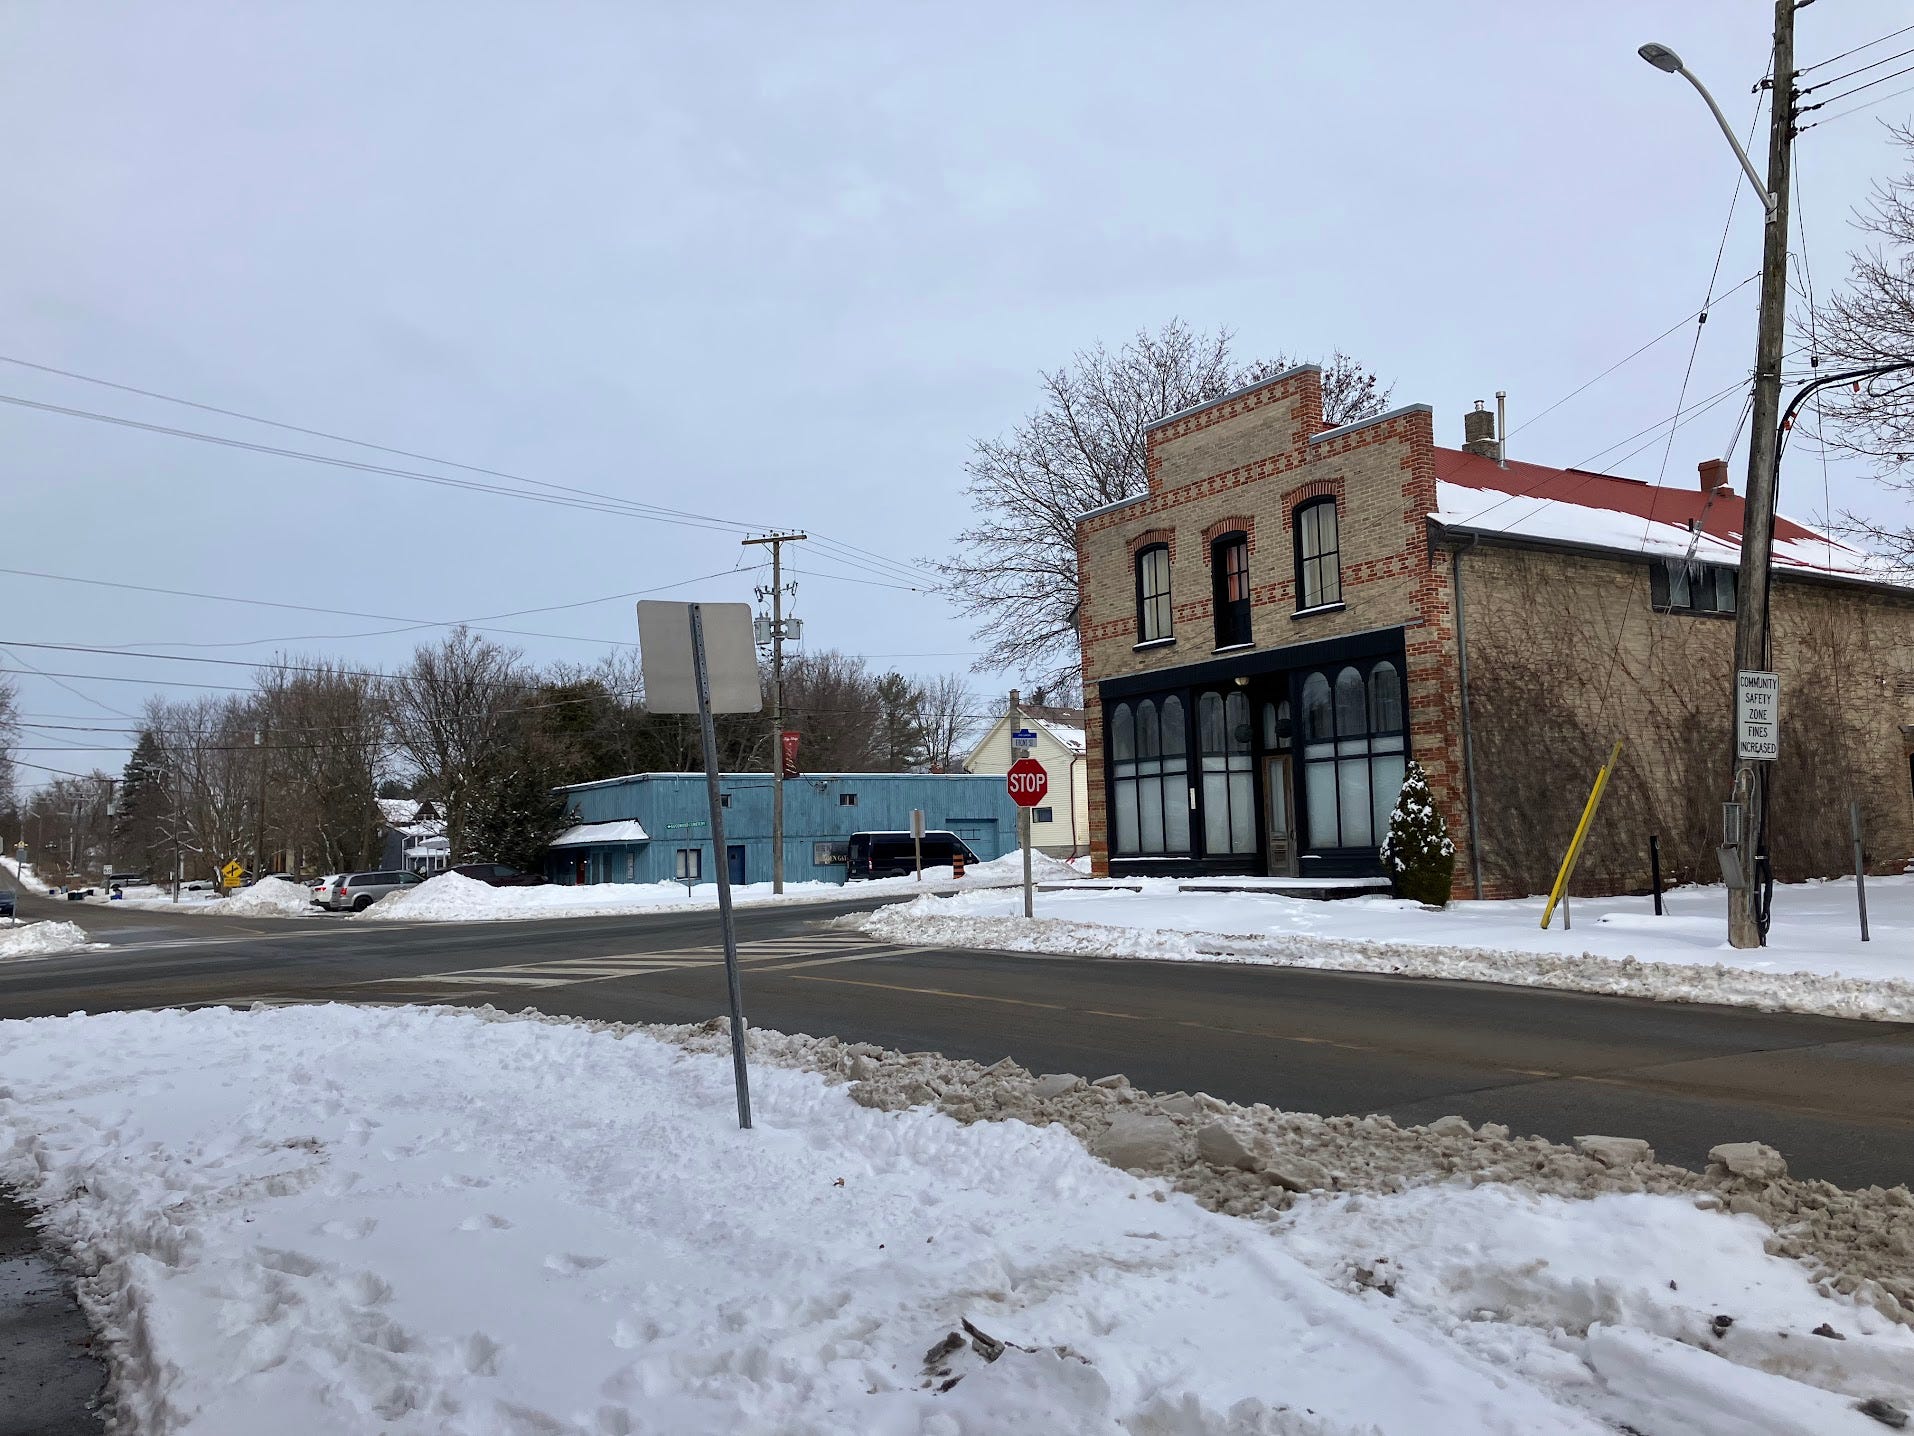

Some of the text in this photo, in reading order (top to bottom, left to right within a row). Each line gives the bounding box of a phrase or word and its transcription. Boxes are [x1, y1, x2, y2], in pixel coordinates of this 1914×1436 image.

[1741, 676, 1777, 690] COMMUNITY
[1745, 693, 1772, 705] SAFETY
[1749, 709, 1767, 720] ZONE
[1748, 726, 1768, 738] FINES
[1741, 741, 1776, 754] INCREASED
[1010, 773, 1046, 793] STOP
